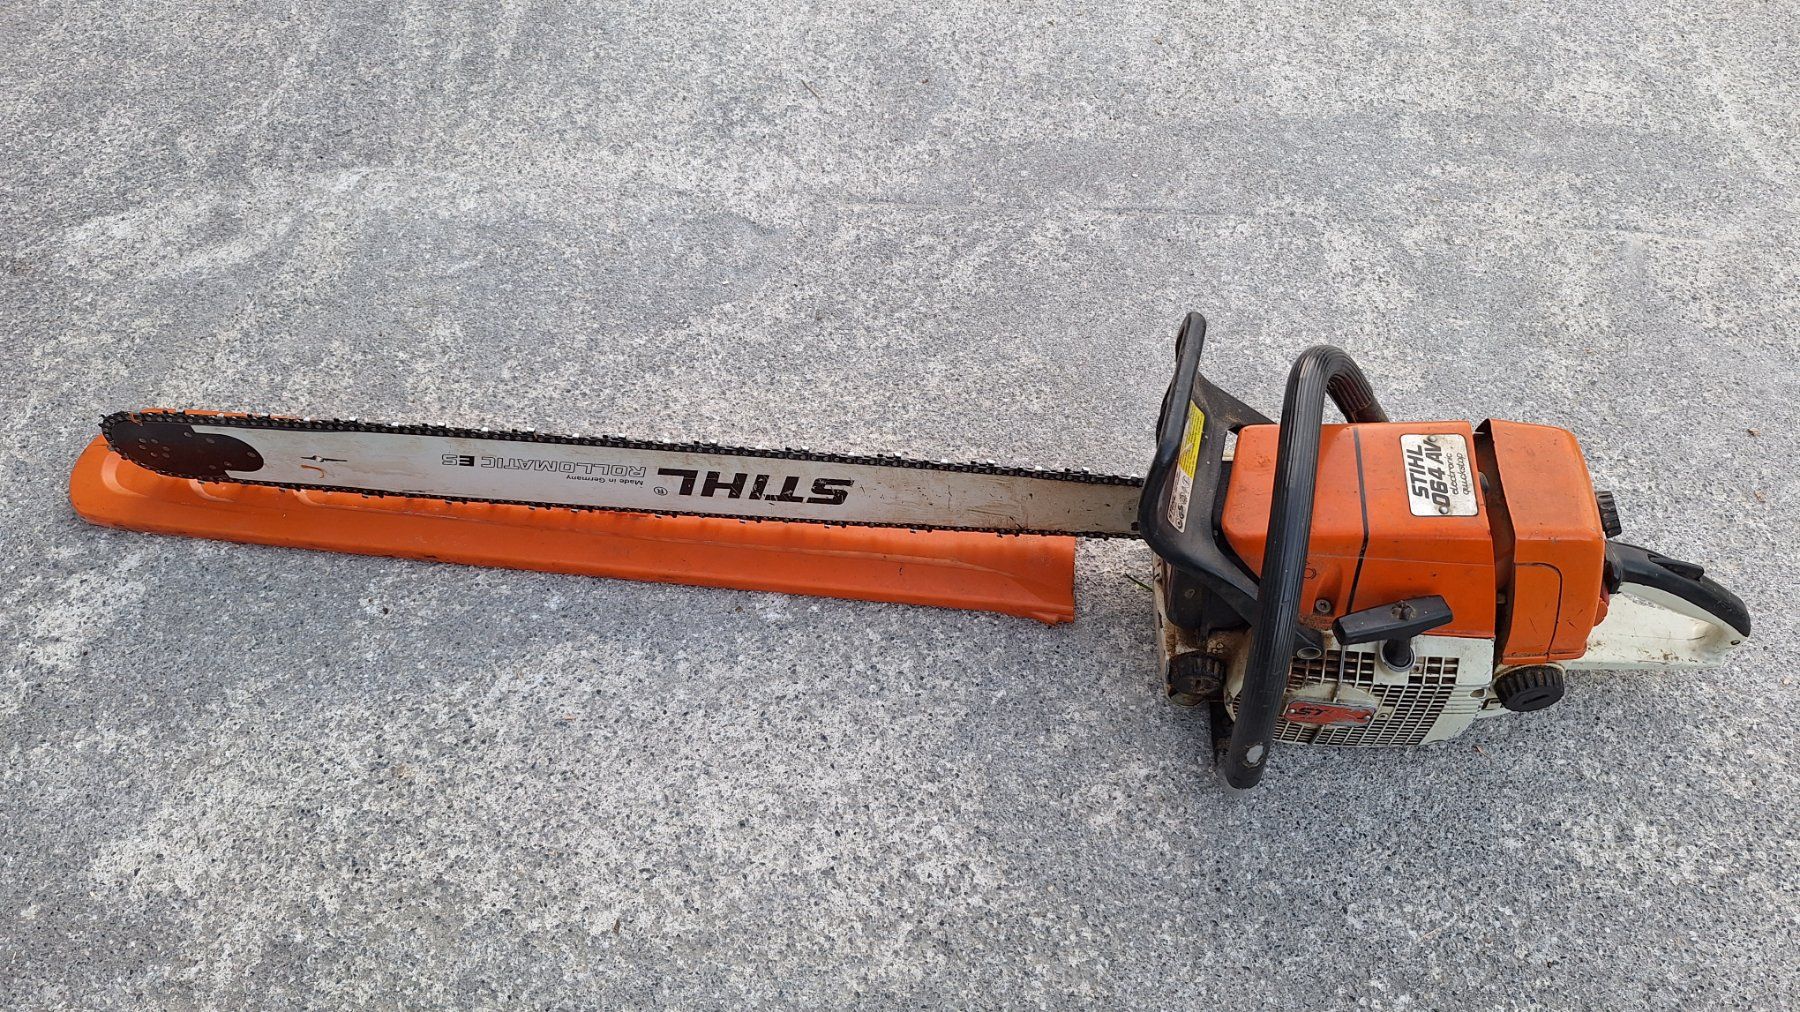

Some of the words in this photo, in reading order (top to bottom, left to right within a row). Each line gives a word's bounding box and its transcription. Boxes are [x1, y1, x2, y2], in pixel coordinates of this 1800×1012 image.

[441, 454, 475, 467] ES
[1423, 439, 1444, 465] AV
[480, 457, 646, 478] ROLLOMATIC
[566, 474, 606, 484] Germany
[1406, 445, 1430, 499] STIHL
[1445, 452, 1459, 495] electronic
[1457, 452, 1471, 496] quickstop
[608, 477, 617, 485] in
[619, 478, 644, 486] Made
[658, 468, 854, 505] STIHL
[1427, 466, 1451, 507] 064
